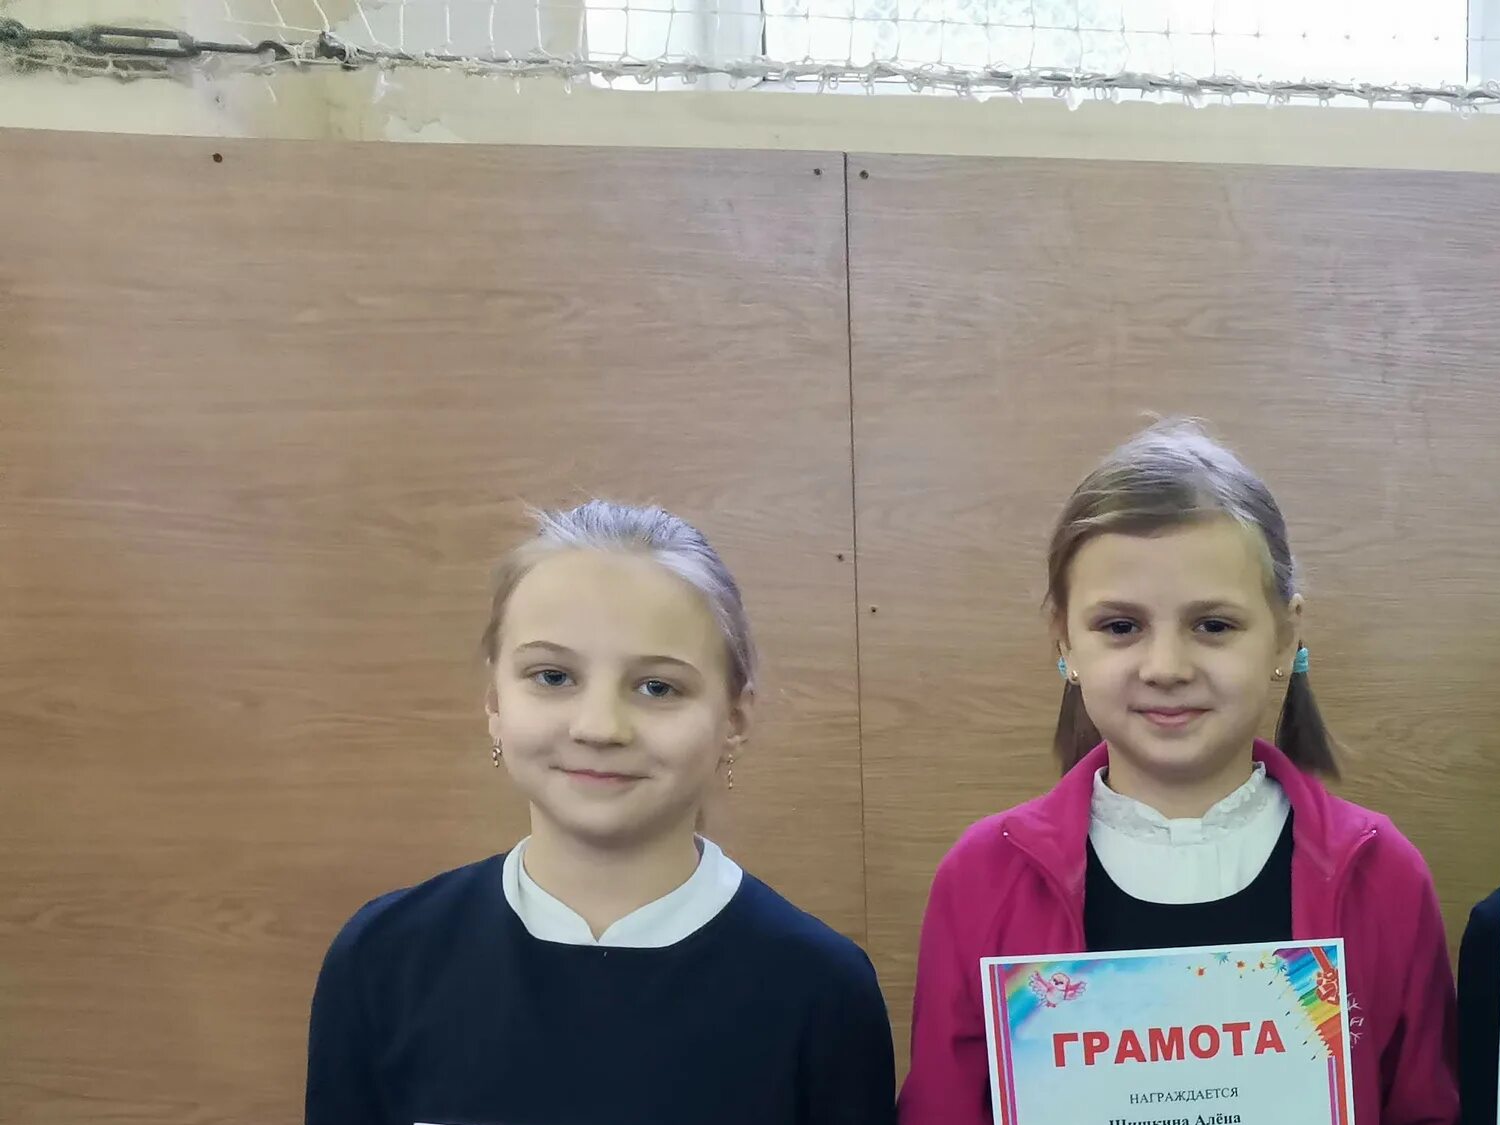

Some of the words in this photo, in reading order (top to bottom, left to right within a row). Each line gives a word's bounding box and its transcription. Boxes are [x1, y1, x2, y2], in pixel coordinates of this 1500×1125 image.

[1053, 1021, 1285, 1067] ГРАМОТА
[1129, 1086, 1238, 1104] НАГРАЖДАЕТСЯ
[1194, 1113, 1241, 1125] Алёна
